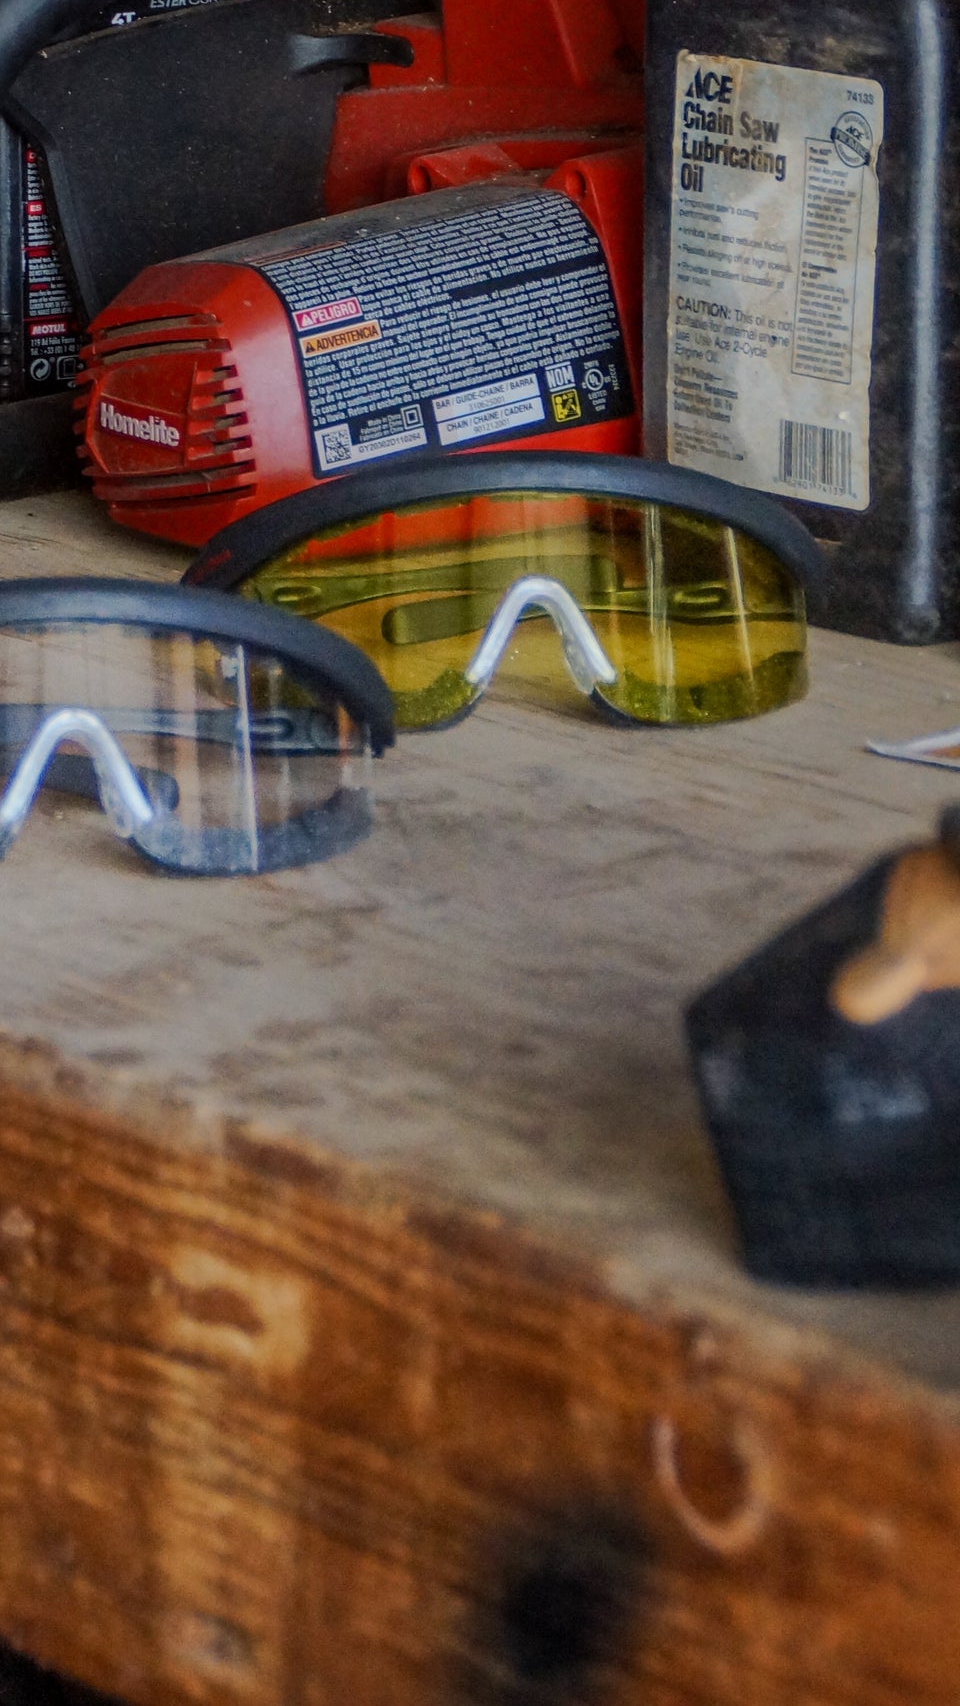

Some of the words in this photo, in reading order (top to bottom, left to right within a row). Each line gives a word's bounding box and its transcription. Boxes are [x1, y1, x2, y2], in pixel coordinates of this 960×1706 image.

[111, 10, 136, 26] 4T
[684, 63, 733, 104] ACE
[683, 100, 733, 136] Chain
[739, 109, 779, 143] Saw
[682, 131, 785, 182] Lubricating
[680, 161, 703, 192] Oil
[310, 300, 357, 323] PELIGRO
[675, 295, 731, 319] CAUTION:
[734, 309, 752, 324] This
[32, 323, 65, 334] MOTUL
[315, 324, 378, 350] ADVERTENCIA
[714, 336, 730, 350] Ace
[545, 364, 575, 388] NOM
[435, 398, 451, 409] BAR
[509, 376, 534, 390] BARRA
[100, 401, 180, 447] Homelite
[446, 419, 468, 431] CHAIN
[503, 402, 533, 417] CADENA
